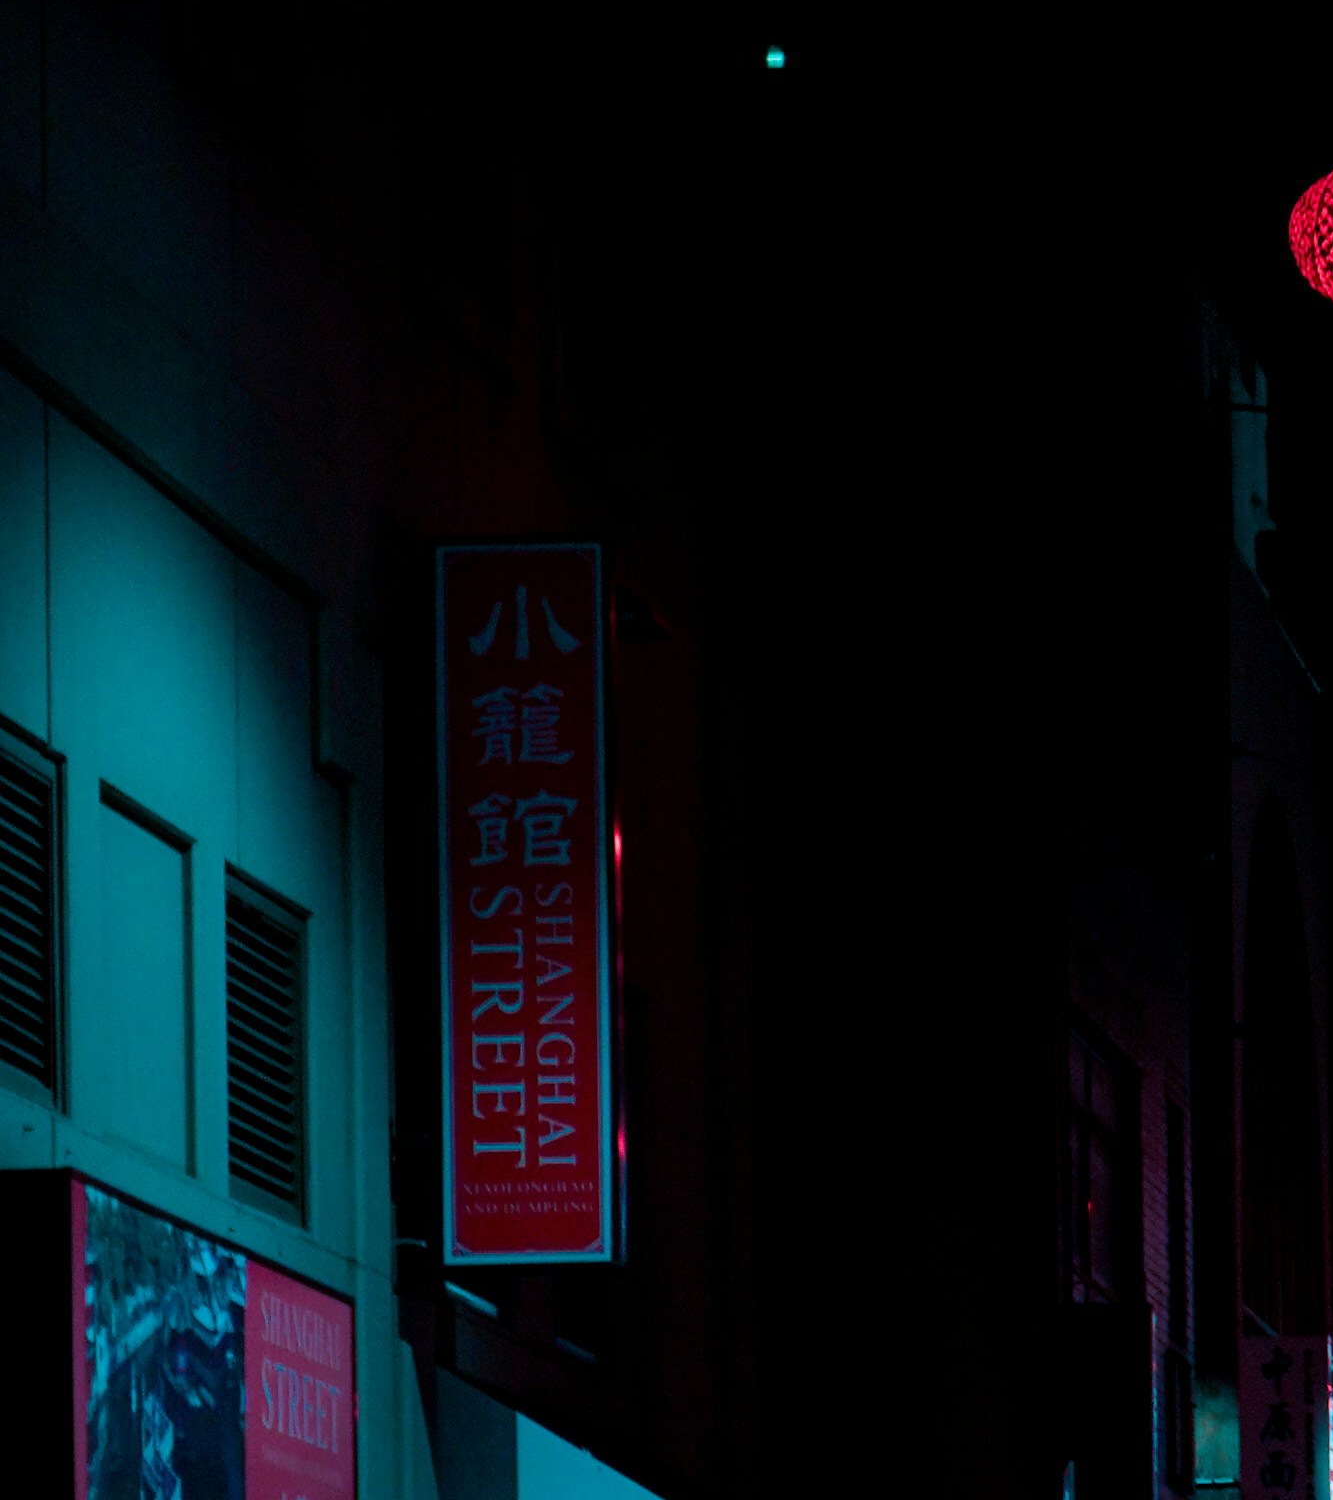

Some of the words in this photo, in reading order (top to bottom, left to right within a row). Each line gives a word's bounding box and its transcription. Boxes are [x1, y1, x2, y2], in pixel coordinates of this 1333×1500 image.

[467, 584, 583, 871] 小籠館
[468, 882, 528, 1171] STREET
[534, 880, 579, 1168] SHANGHAI
[261, 1358, 340, 1455] STREET
